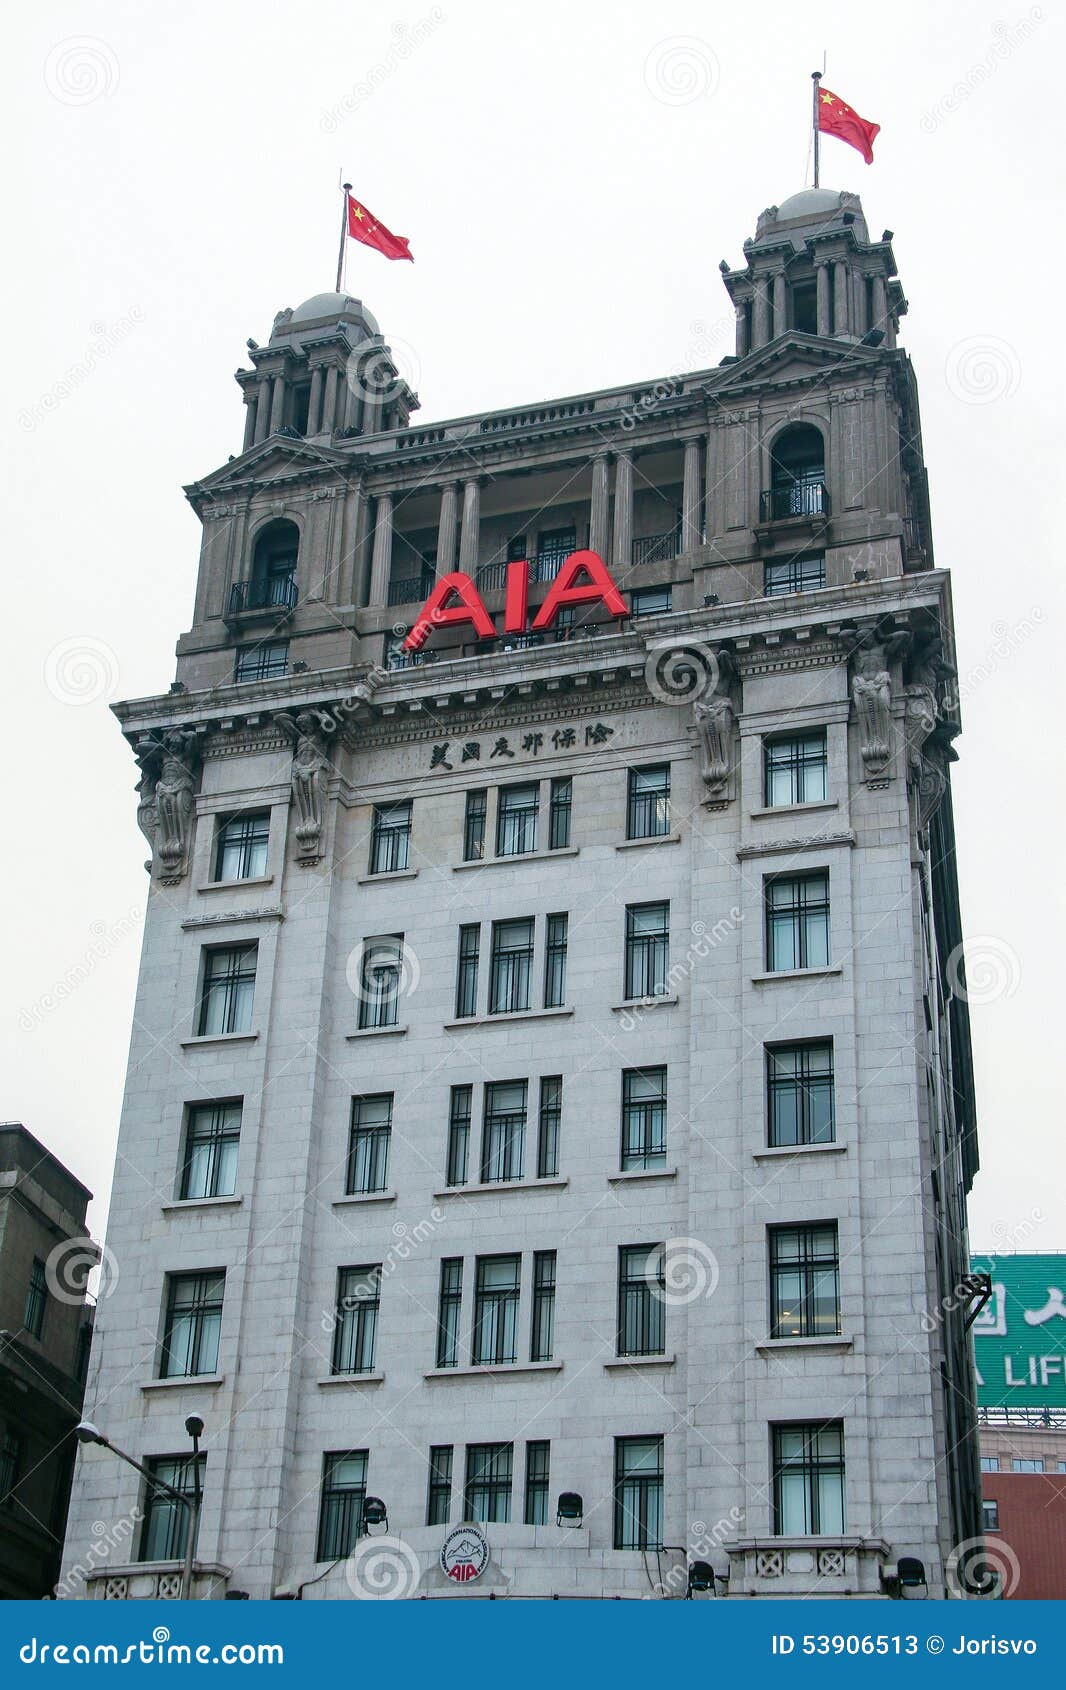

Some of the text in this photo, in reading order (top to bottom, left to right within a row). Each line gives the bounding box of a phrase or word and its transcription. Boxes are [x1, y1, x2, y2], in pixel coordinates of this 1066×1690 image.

[400, 549, 630, 653] AIA
[1004, 1355, 1066, 1386] LIF
[448, 1563, 479, 1582] AIA
